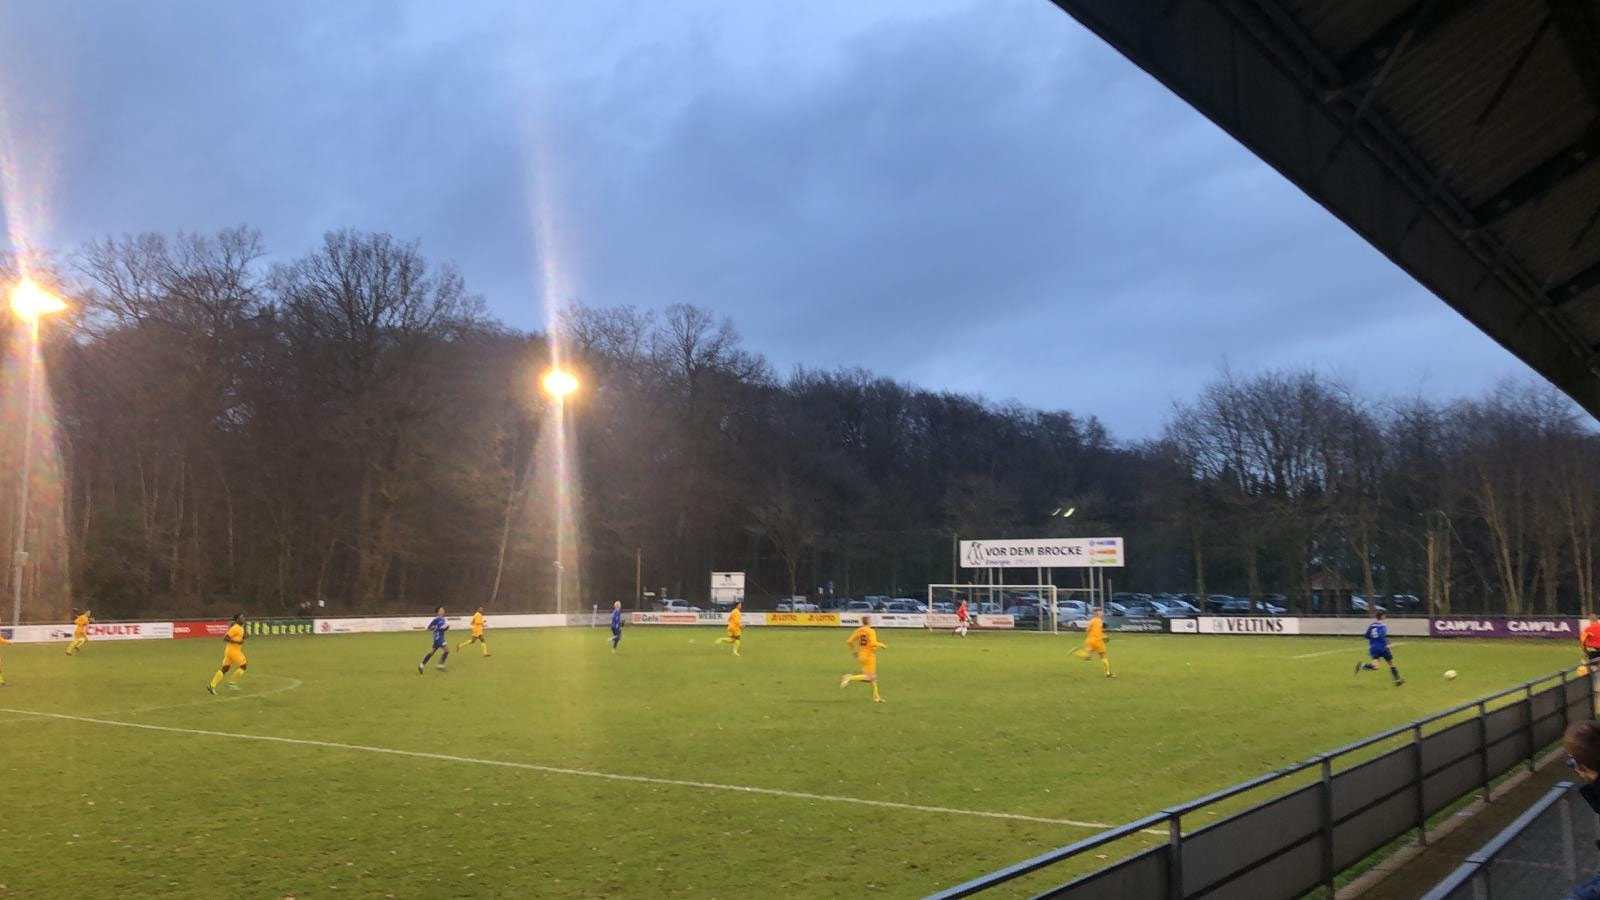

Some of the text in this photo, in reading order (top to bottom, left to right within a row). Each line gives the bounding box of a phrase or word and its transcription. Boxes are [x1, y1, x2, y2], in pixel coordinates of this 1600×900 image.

[985, 546, 1082, 556] VOR DEM BROCKE
[85, 625, 141, 635] CHULTE
[246, 620, 313, 635] itburger
[1227, 618, 1284, 632] VELTINS
